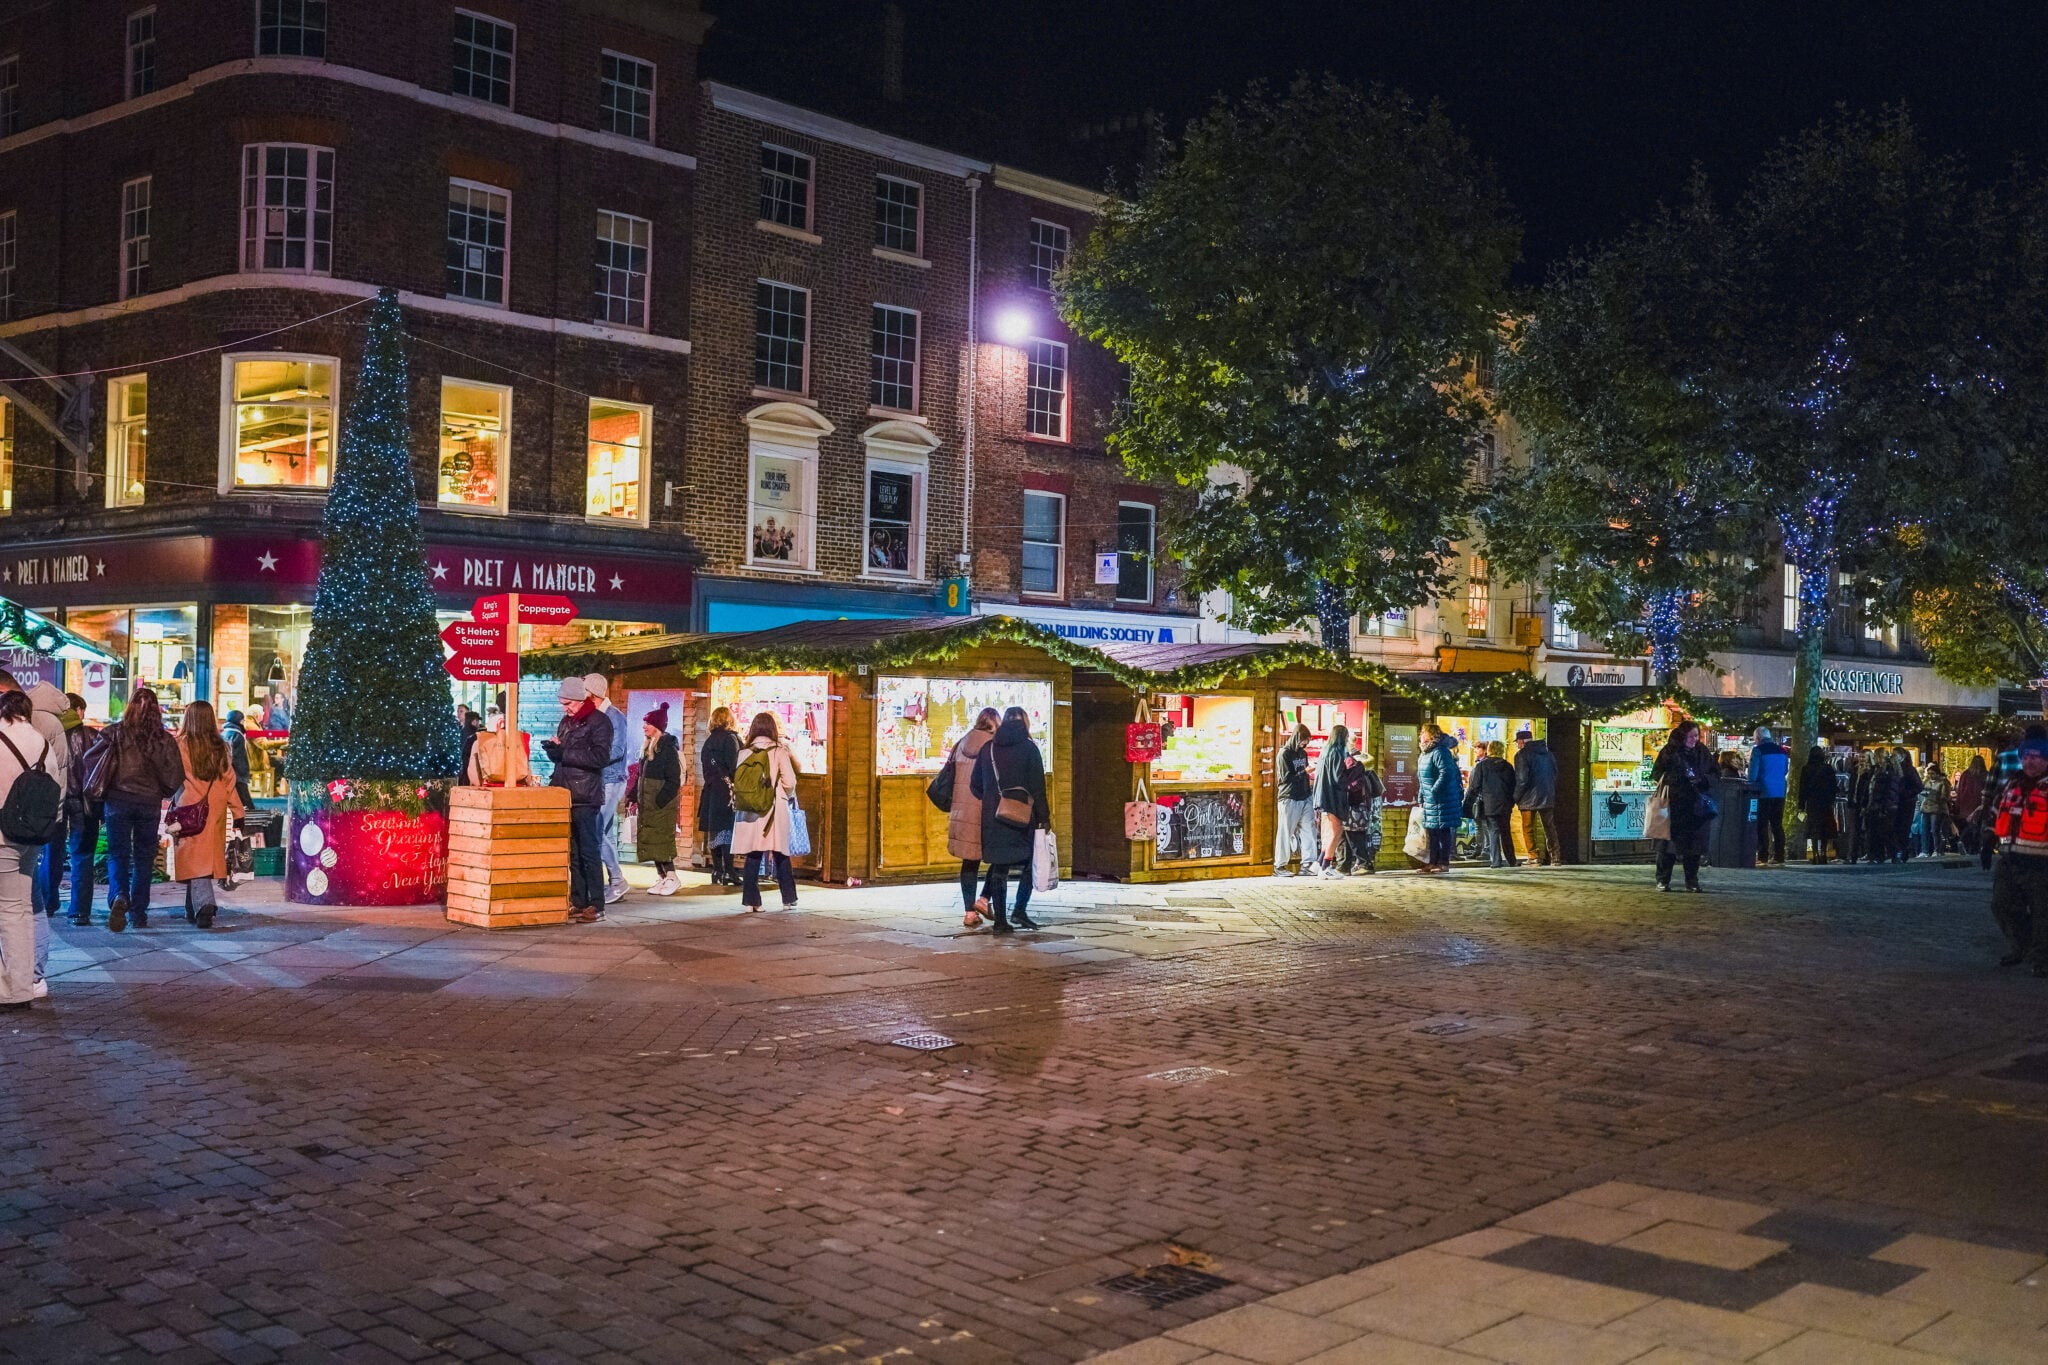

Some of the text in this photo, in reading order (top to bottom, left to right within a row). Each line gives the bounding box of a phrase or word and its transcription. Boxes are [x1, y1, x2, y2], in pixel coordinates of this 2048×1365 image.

[18, 554, 89, 586] PRET A MANGER
[464, 558, 596, 592] PRET A MANGER
[483, 601, 498, 611] King's
[518, 604, 570, 615] Coppergate
[482, 612, 499, 620] Square
[456, 626, 500, 636] St Helen's
[1056, 624, 1108, 640] BUILDING
[1110, 628, 1154, 643] SOCIETY
[461, 636, 494, 646] Square
[12, 654, 39, 667] MADE
[463, 657, 500, 666] Museum
[463, 667, 500, 676] Gardens
[1585, 666, 1625, 684] Amorino
[382, 872, 419, 889] New
